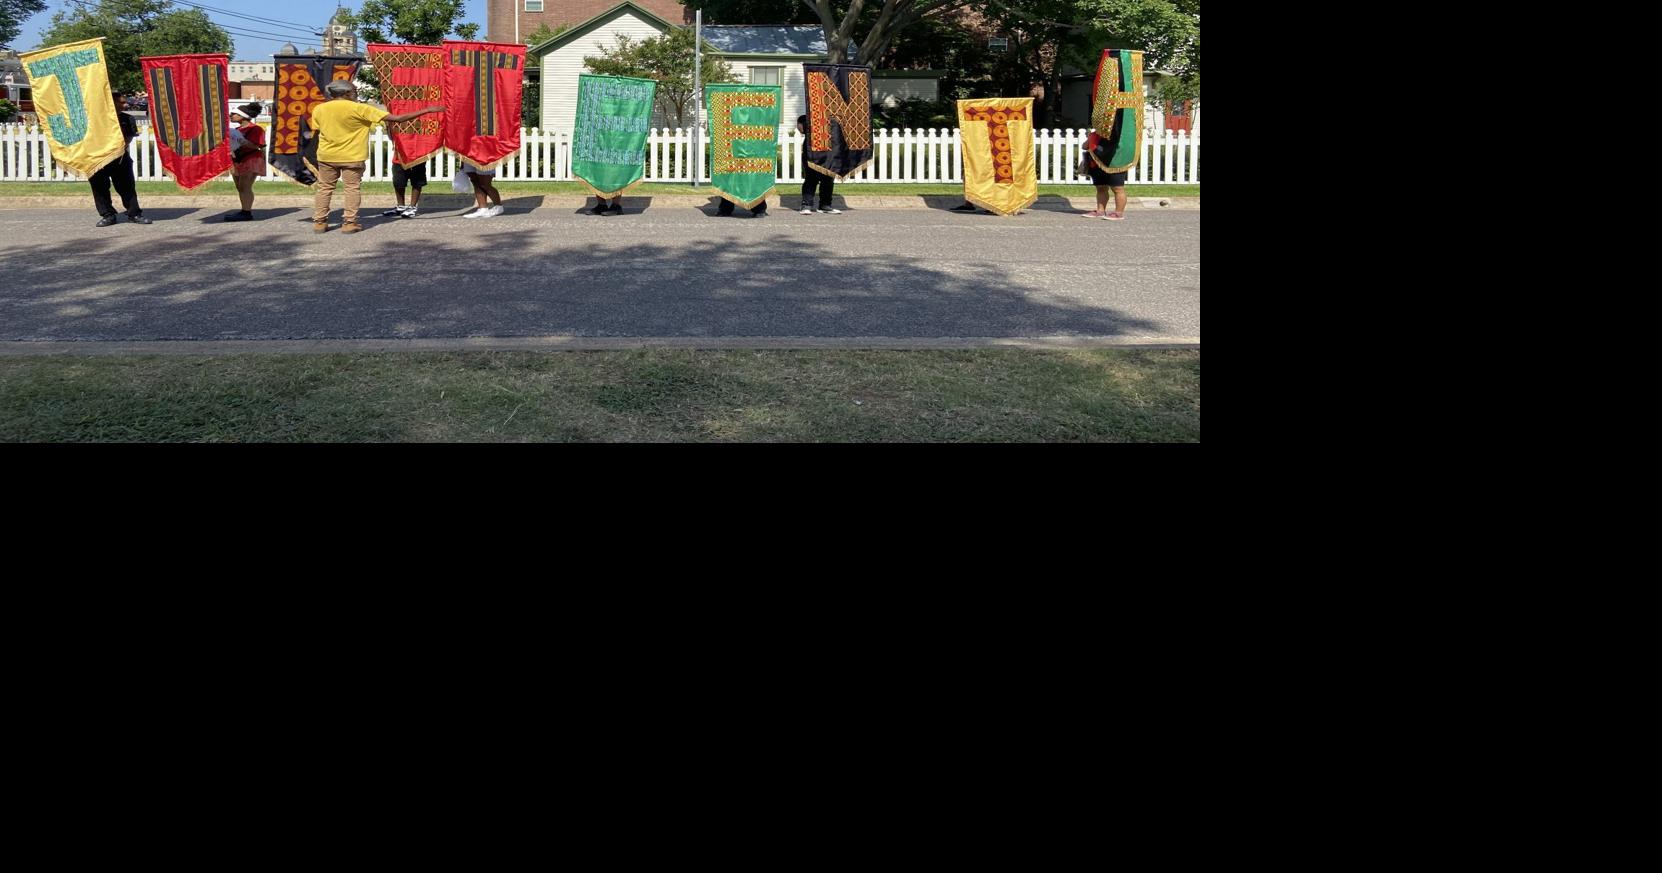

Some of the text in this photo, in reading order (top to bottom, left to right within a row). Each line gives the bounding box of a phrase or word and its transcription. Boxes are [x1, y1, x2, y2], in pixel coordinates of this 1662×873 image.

[28, 48, 99, 146] J
[150, 64, 223, 156] U
[373, 51, 442, 135] E
[451, 50, 518, 136] T
[579, 80, 650, 165] E
[711, 91, 776, 174] E
[807, 71, 872, 151] N
[1092, 57, 1143, 142] H
[964, 106, 1027, 183] T
